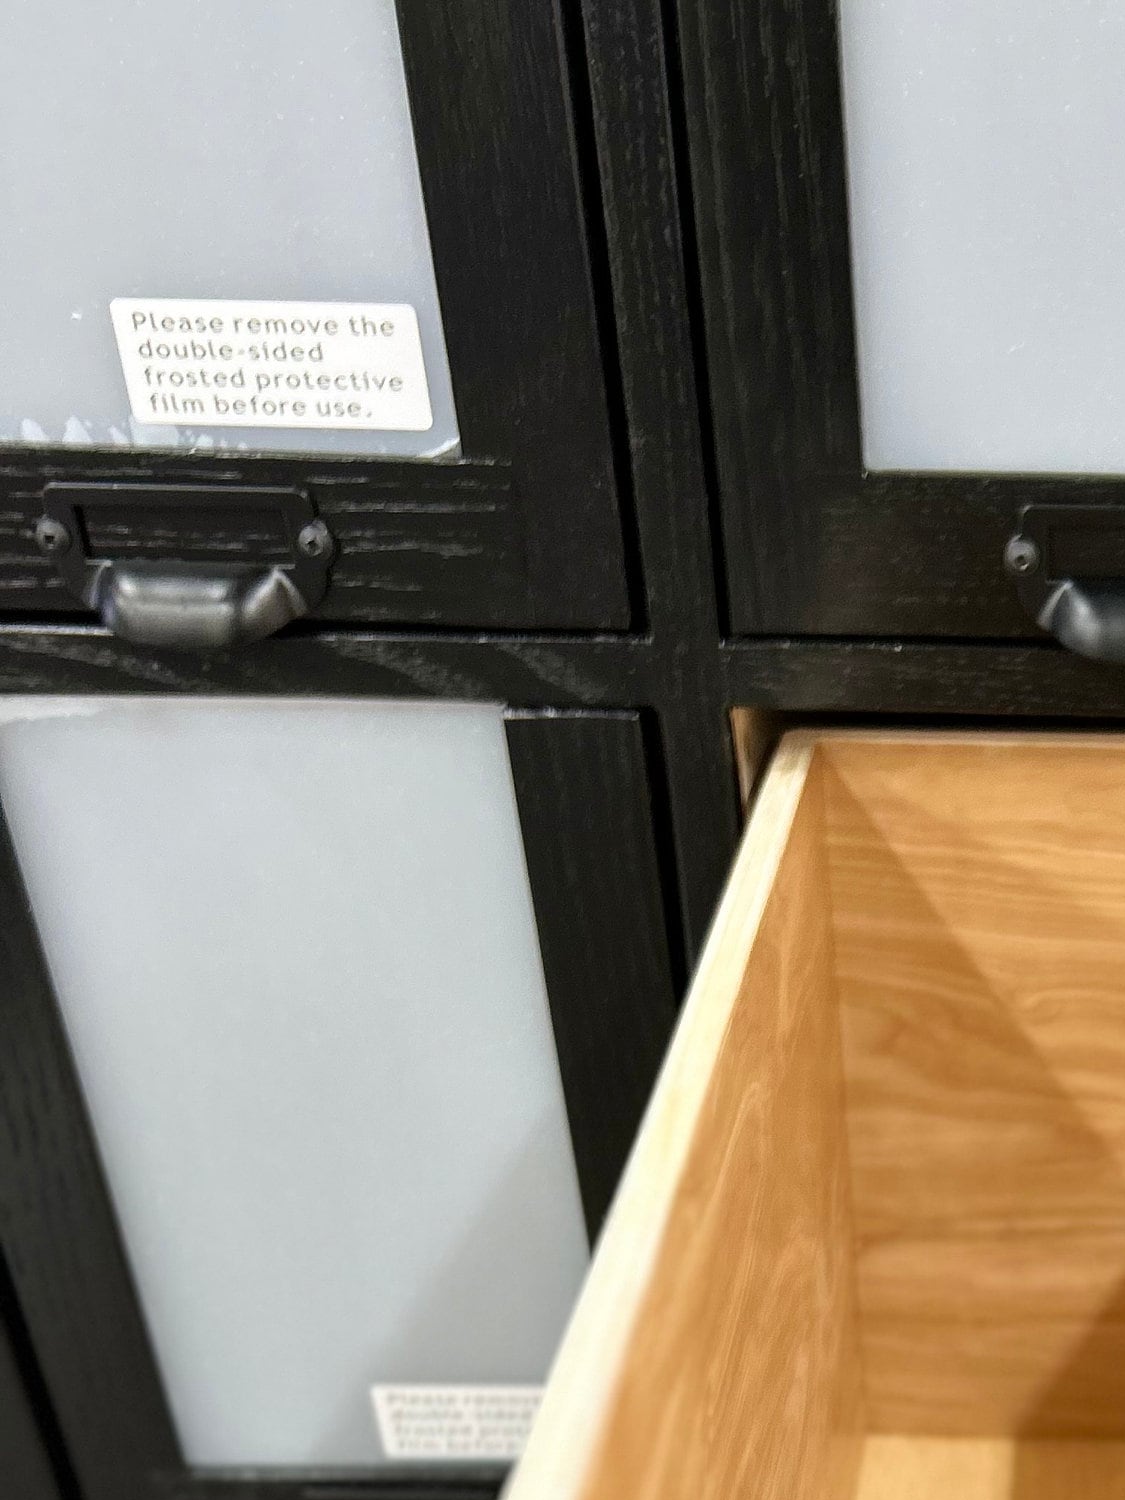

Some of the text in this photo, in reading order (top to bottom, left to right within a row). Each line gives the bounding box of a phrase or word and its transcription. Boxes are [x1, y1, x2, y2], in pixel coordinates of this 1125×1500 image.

[131, 311, 395, 337] Please remove the
[138, 339, 324, 362] double-sided
[144, 365, 403, 393] frosted protective
[150, 392, 373, 419] film before use.
